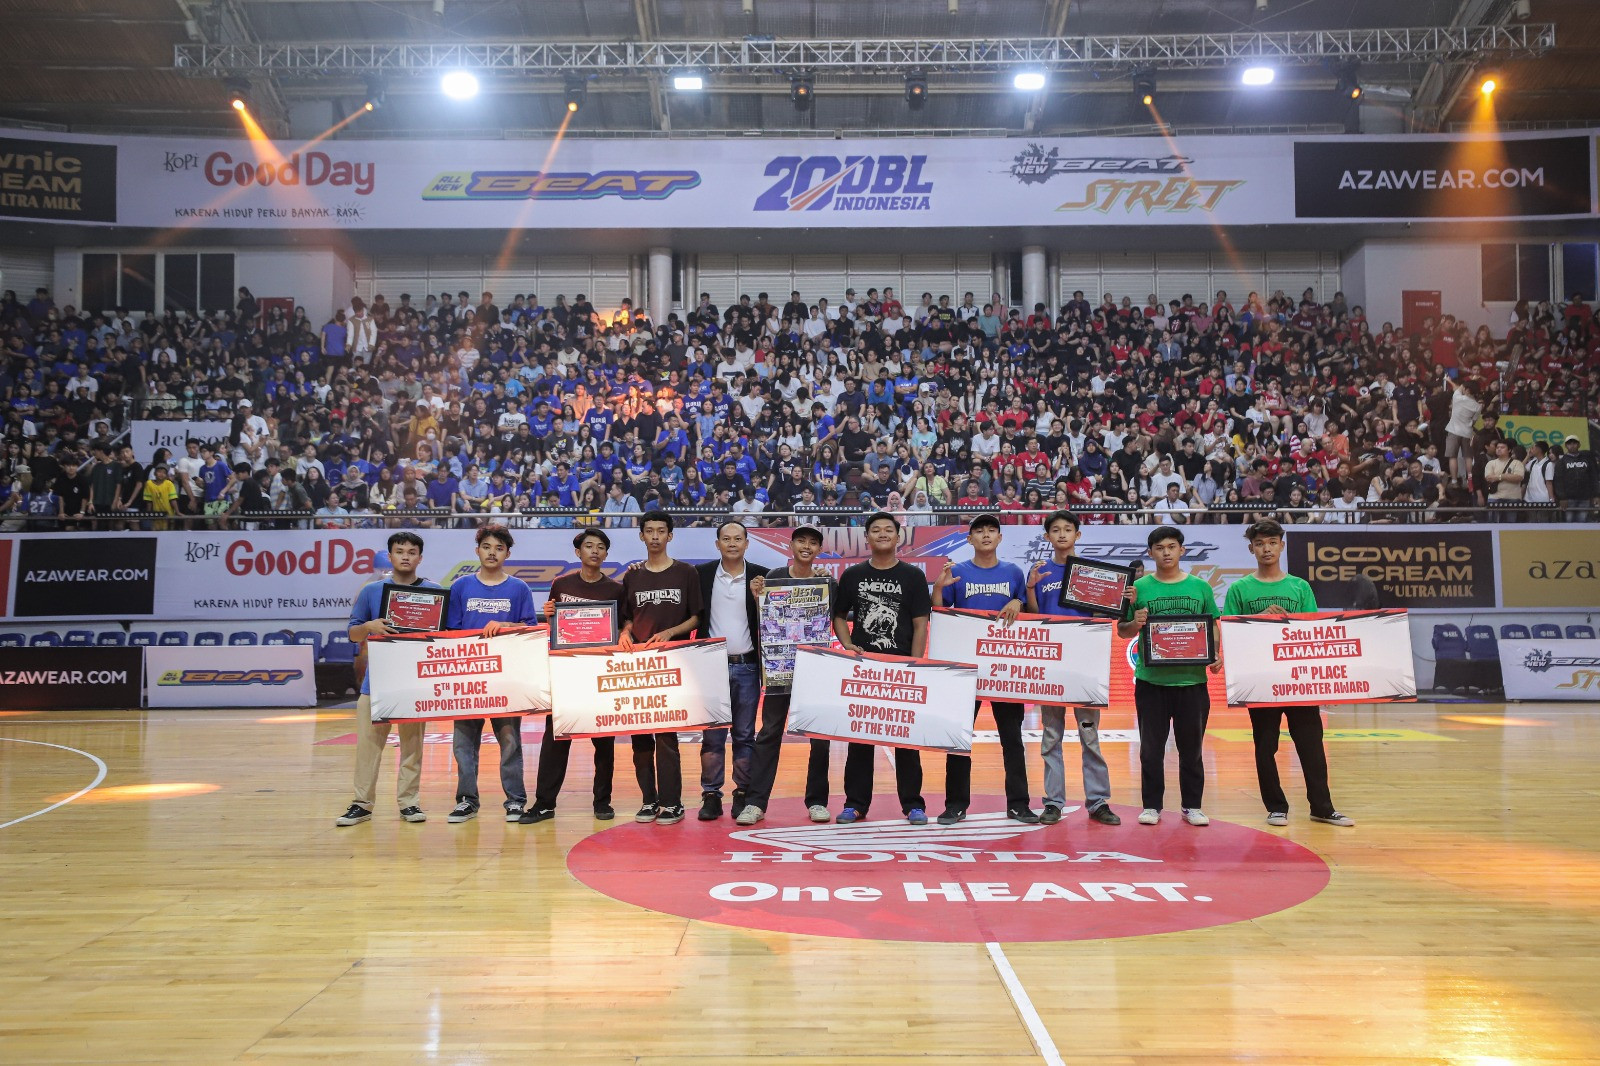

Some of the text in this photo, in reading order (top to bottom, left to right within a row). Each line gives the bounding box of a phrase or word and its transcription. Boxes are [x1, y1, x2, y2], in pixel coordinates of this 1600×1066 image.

[1014, 164, 1048, 174] NEW
[1022, 156, 1048, 166] ALL
[204, 151, 300, 187] Good
[306, 151, 375, 195] Day
[438, 175, 463, 183] ALL
[1338, 167, 1544, 190] AZAWEAR.COM
[0, 172, 82, 194] EAM
[432, 183, 463, 192] NEW
[0, 193, 82, 211] LTRA MILK
[833, 196, 931, 211] INDONESIA
[1056, 178, 1247, 215] STREET
[175, 207, 360, 218] KARENA HIDUP PERLU BANYAK RASA
[1566, 461, 1588, 469] NASA
[30, 501, 47, 513] 27
[225, 540, 321, 576] Good
[328, 539, 375, 575] Da
[1030, 550, 1055, 560] NE
[24, 568, 148, 582] AZAWEAR.COM
[1308, 565, 1473, 581] ICE CREAM
[1528, 560, 1600, 580] aza
[858, 581, 902, 594] SMEKDA
[1395, 584, 1436, 598] ULTRA
[1440, 584, 1474, 597] MILK
[194, 598, 352, 609] KARENA HIDUP PERLU BANYAK
[987, 624, 1050, 641] Satu HATI
[1281, 626, 1346, 641] Satu HATI
[426, 643, 488, 659] Satu HATI
[979, 643, 1058, 658] ALMAMATER
[1277, 644, 1358, 658] ALMAMATER
[421, 660, 499, 676] ALMAMATER
[606, 656, 667, 673] Satu HATI
[990, 663, 1046, 680] 2ND PLACE
[1291, 665, 1347, 680] 4TH PLACE
[0, 671, 127, 685] ZAWEAR.COM
[601, 674, 678, 690] ALMAMATER
[853, 665, 916, 684] Satu HATI
[1555, 670, 1600, 691] ST
[434, 681, 488, 697] 5TH PLACE
[844, 684, 923, 701] ALMAMATER
[976, 679, 1064, 696] UPPORTER AWARD
[1272, 681, 1370, 696] SUPPORTER AWARD
[415, 696, 508, 712] SUPPORTER AWARD
[614, 695, 667, 711] 3RD PLACE
[595, 709, 688, 727] SUPPORTER AWARD
[848, 703, 916, 724] SUPPORTER
[851, 720, 910, 738] OF THE YEAR
[721, 851, 1163, 863] HONDA
[708, 881, 1213, 902] One HEART.
